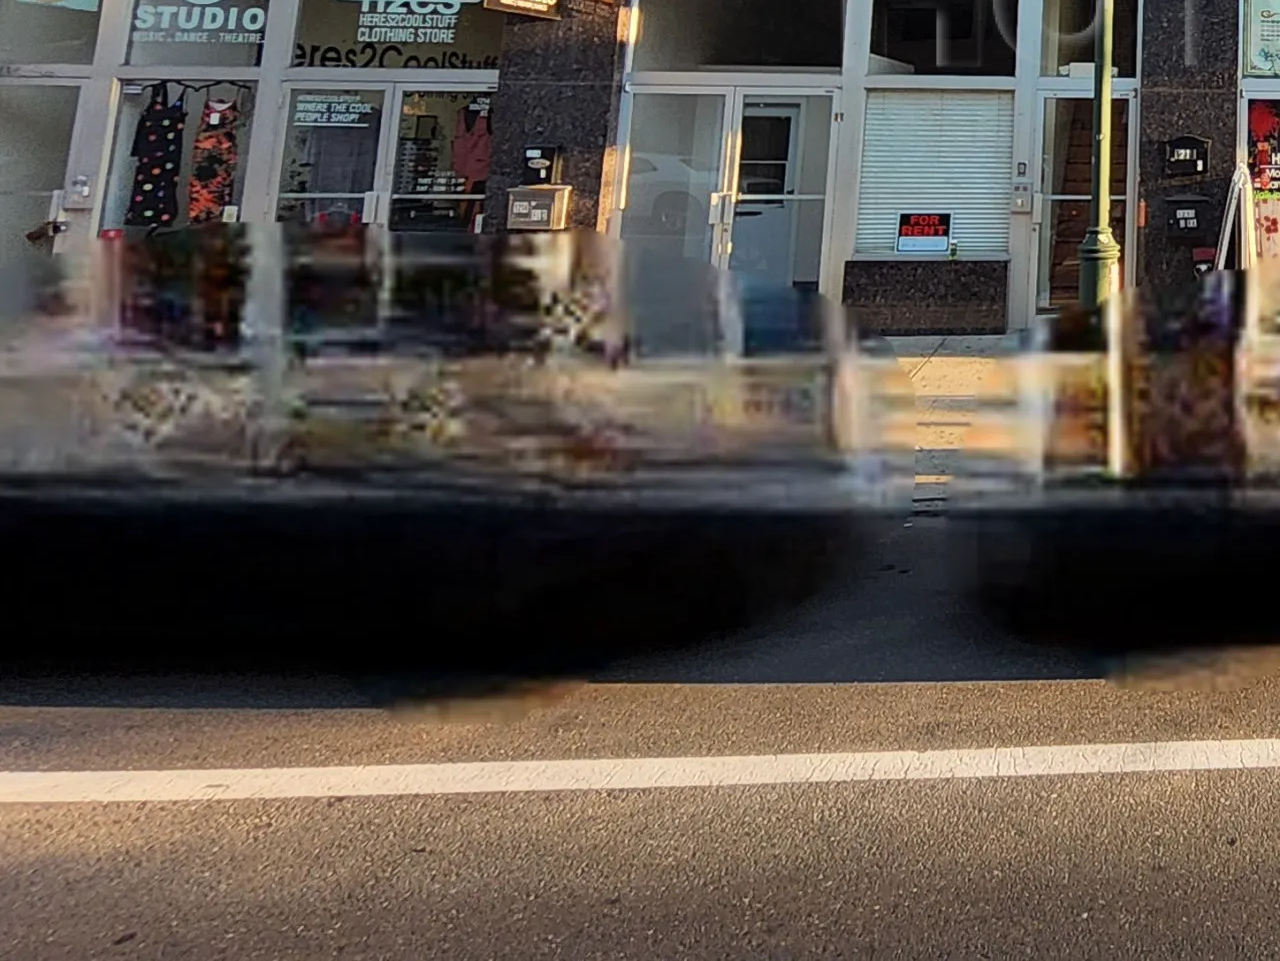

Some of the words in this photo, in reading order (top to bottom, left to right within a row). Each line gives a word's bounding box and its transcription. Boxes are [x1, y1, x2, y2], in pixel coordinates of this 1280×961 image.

[134, 4, 266, 31] STUDIO
[358, 13, 459, 28] HERES2COOLSTUFF
[174, 32, 210, 43] DANCE
[219, 32, 264, 44] THEATRE
[357, 27, 415, 42] CLOTHING
[416, 28, 456, 43] STORE
[296, 102, 328, 112] WHERE
[330, 103, 348, 112] THE
[349, 103, 373, 113] COOL
[294, 112, 329, 122] PEOPLE
[910, 215, 940, 225] FOR
[901, 225, 948, 236] RENT
